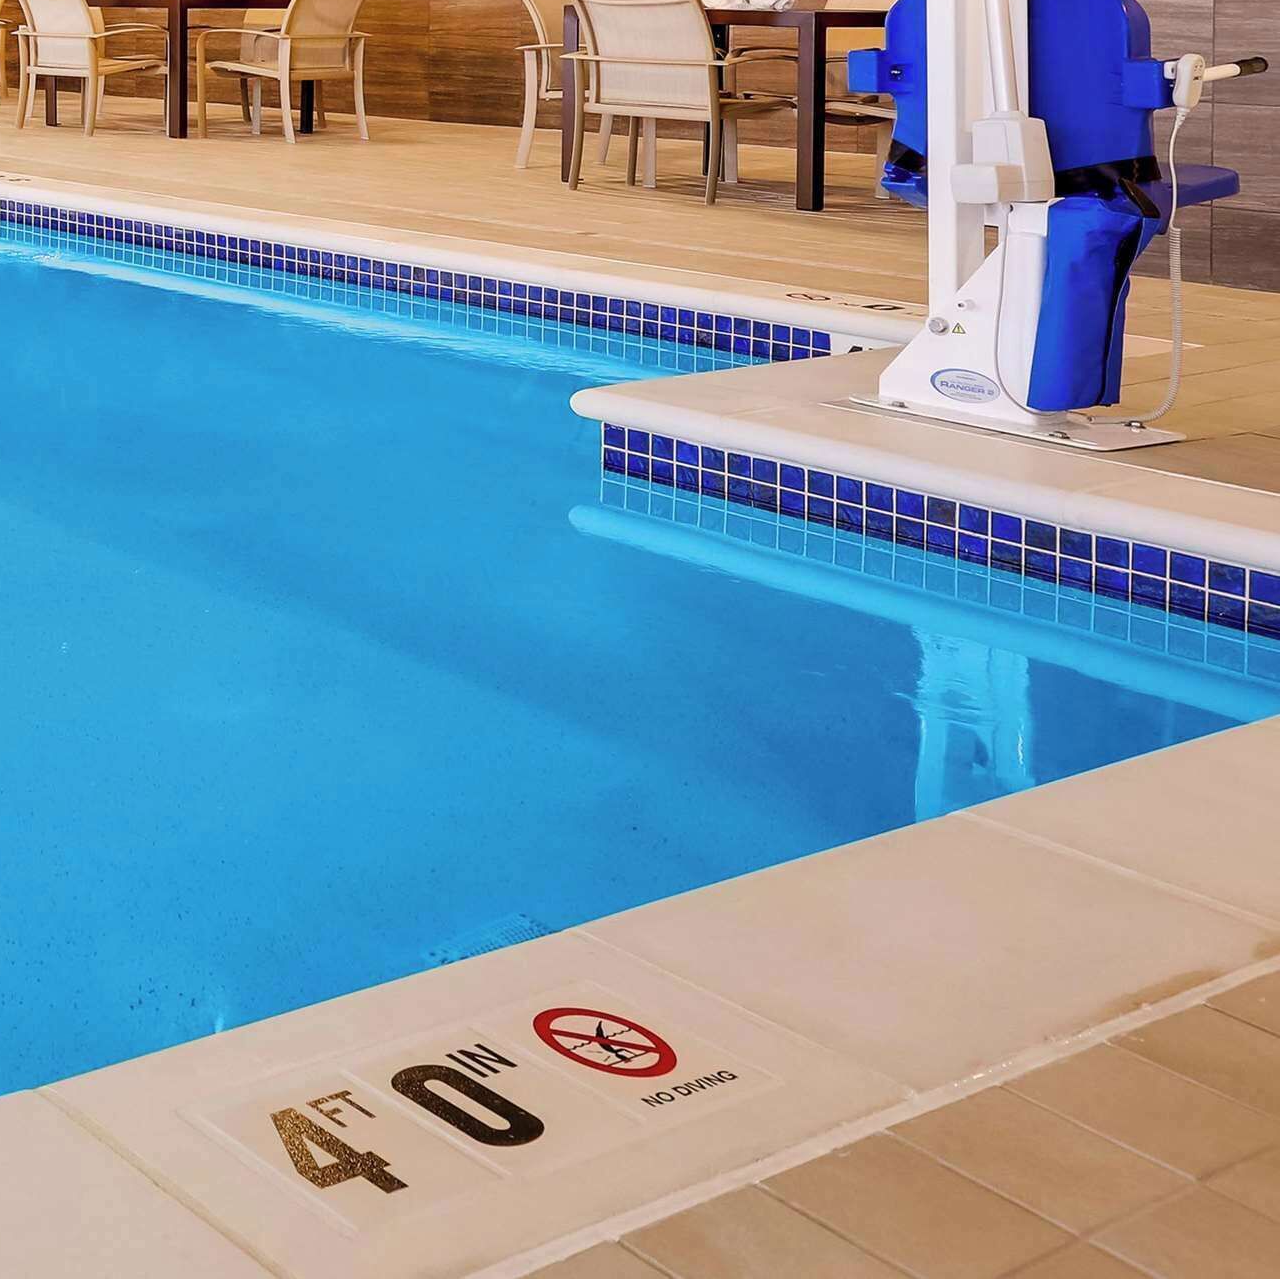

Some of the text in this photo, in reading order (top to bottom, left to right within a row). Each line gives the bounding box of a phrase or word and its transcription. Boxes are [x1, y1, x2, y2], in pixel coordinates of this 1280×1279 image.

[940, 381, 985, 394] RANGER
[641, 1070, 738, 1107] NO DIVING
[269, 1043, 545, 1195] 4 FT 0 IN
